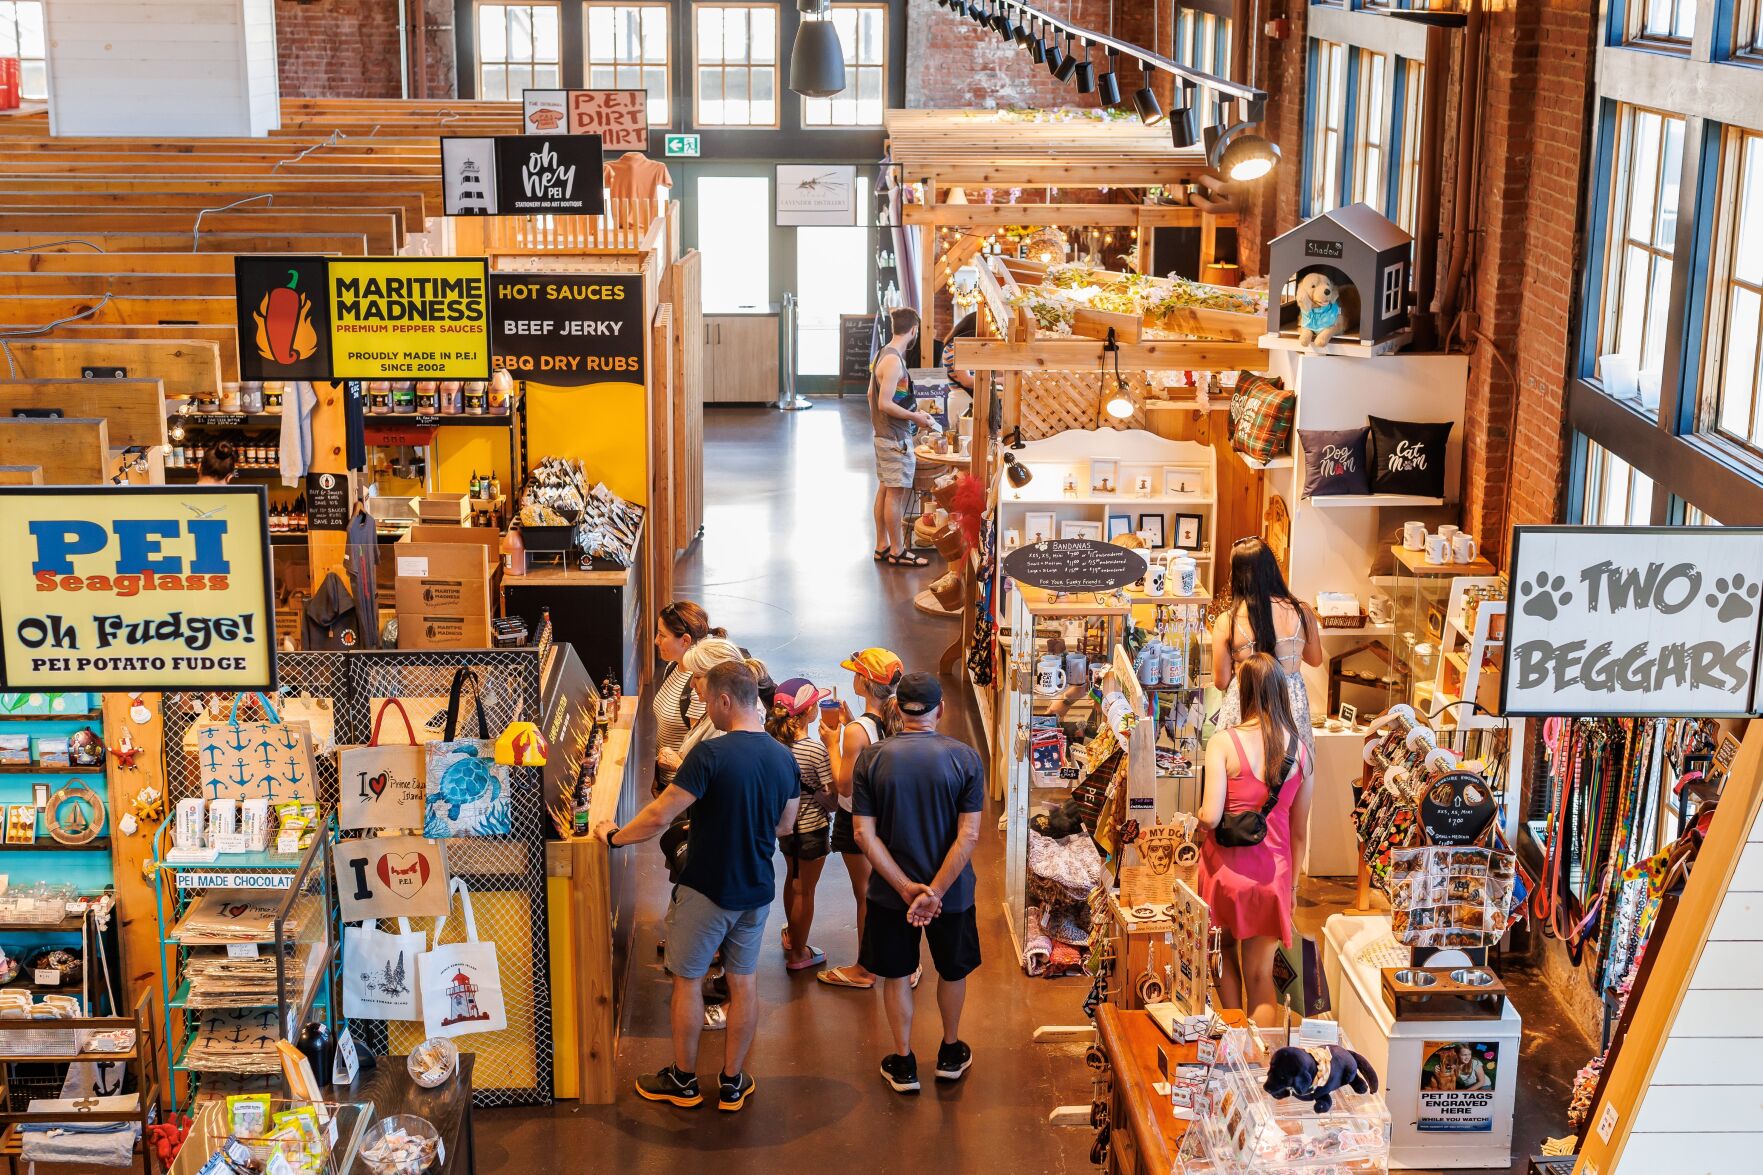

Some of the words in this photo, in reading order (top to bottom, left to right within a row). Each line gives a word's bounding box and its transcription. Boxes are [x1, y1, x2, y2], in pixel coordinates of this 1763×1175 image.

[574, 92, 643, 110] P.E.I.
[577, 109, 644, 128] DIRT
[529, 141, 558, 173] oh
[522, 165, 576, 199] hey
[548, 187, 562, 198] PEI
[1308, 242, 1339, 256] Shadow
[336, 277, 483, 299] MARITIME
[498, 284, 540, 300] HOT
[546, 284, 626, 300] SAUCES
[336, 300, 484, 322] MADNESS
[336, 324, 388, 333] PREMIUM
[392, 324, 436, 333] PEPPER
[440, 324, 484, 333] SAUCES
[504, 320, 554, 335] BEEF
[560, 320, 624, 336] JERKY
[348, 352, 400, 360] PROUDLY
[403, 352, 436, 360] MADE
[440, 352, 450, 360] IN
[456, 352, 477, 360] P.E.I
[492, 355, 534, 370] BBQ
[540, 356, 580, 370] DRY
[587, 356, 639, 371] RUBS
[380, 364, 413, 372] SINCE
[417, 364, 446, 372] 2002
[1322, 444, 1354, 462] Dog
[1396, 440, 1424, 458] Cat
[28, 520, 231, 576] PEI
[1053, 542, 1091, 550] BANDANAS
[35, 569, 230, 597] Seaglass
[1580, 560, 1702, 615] TWO
[17, 614, 80, 650] Oh
[92, 611, 256, 651] Fudge!
[32, 658, 70, 671] PEI
[77, 657, 166, 671] POTATO
[172, 657, 246, 670] FUDGE
[1513, 639, 1752, 694] BEGGARS
[390, 778, 411, 790] Prince
[402, 790, 423, 800] Island
[1084, 786, 1097, 806] PEI
[1150, 828, 1165, 837] MY
[178, 876, 194, 886] PEI
[198, 876, 228, 886] MADE
[350, 858, 373, 900] I
